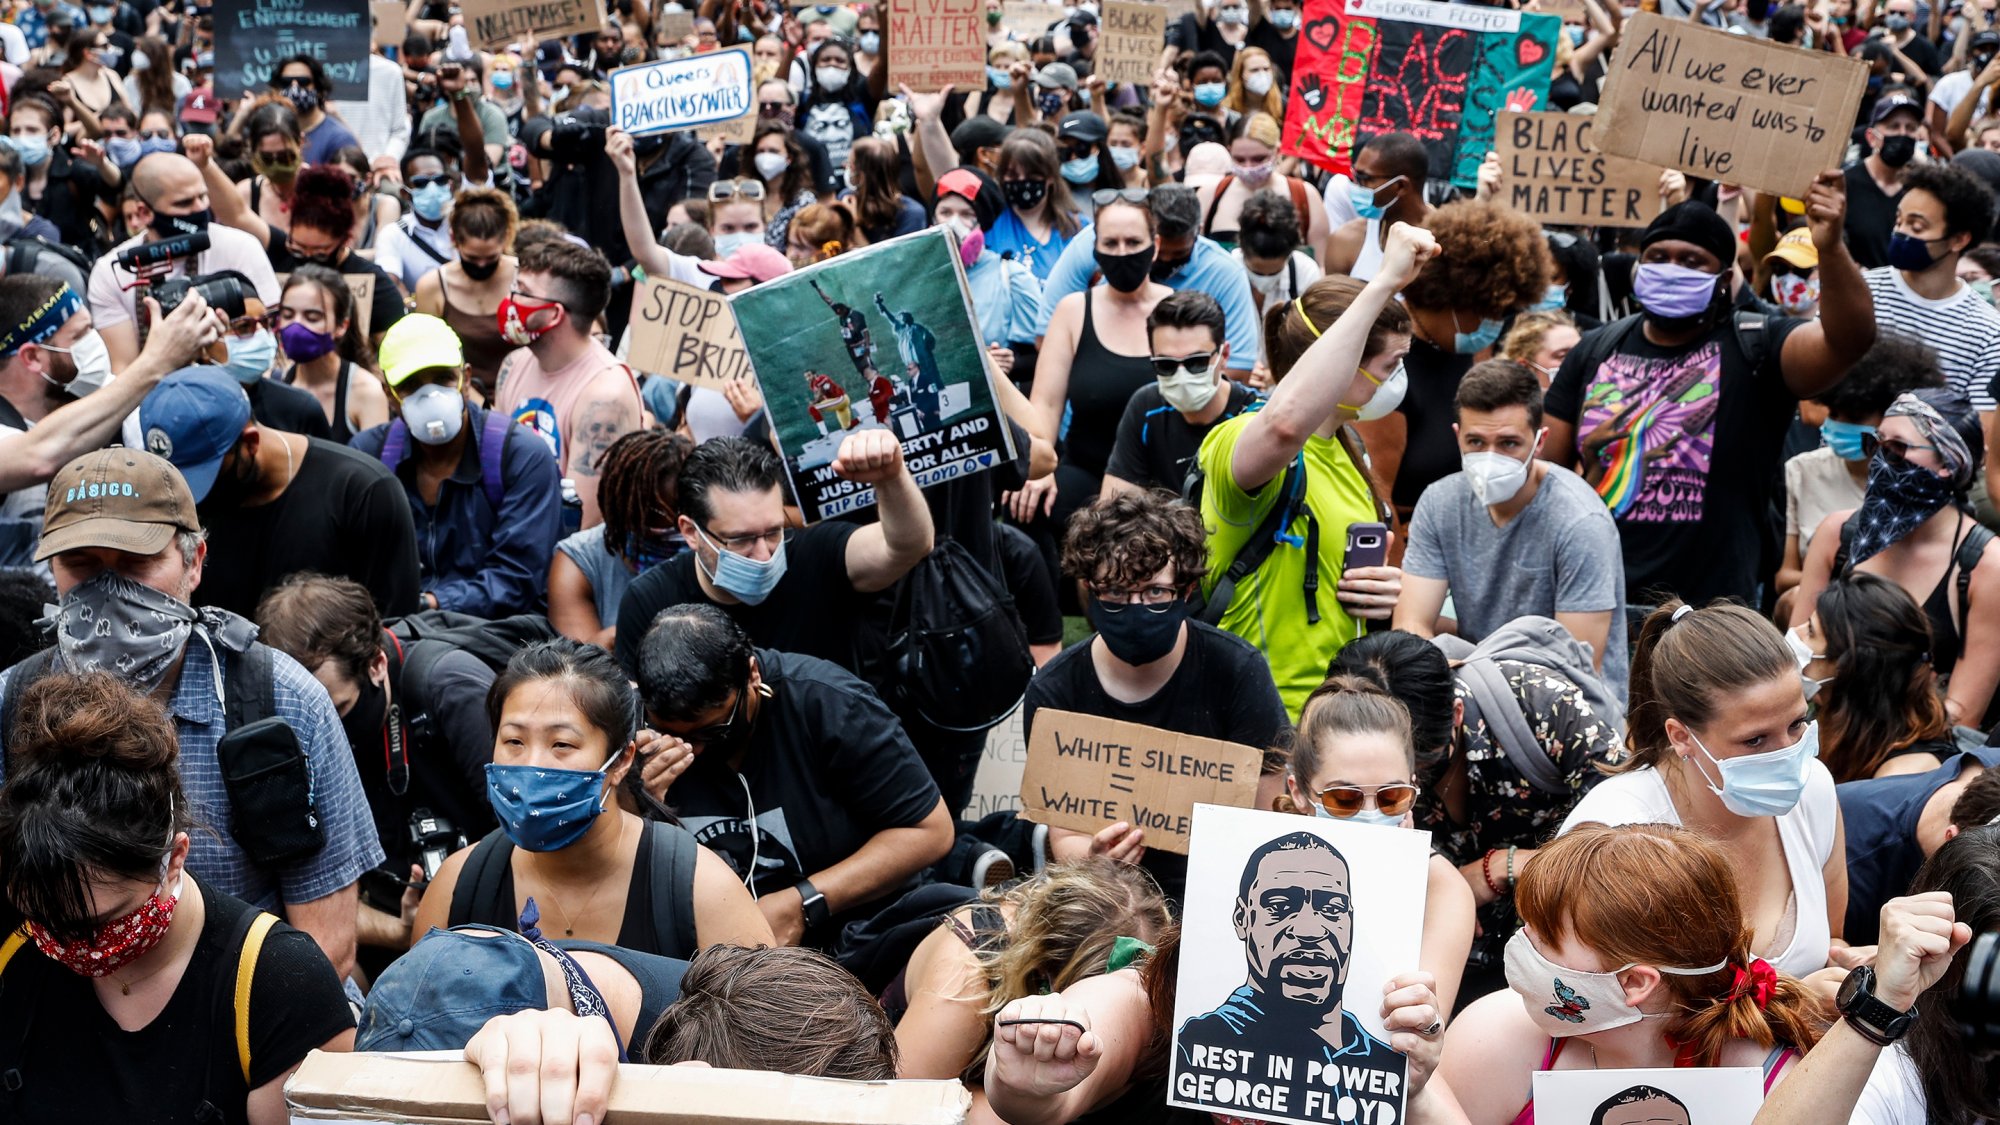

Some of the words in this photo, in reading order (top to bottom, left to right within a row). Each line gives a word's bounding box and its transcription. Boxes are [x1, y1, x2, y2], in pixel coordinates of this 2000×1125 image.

[238, 10, 361, 29] ENFORCEMENT
[1108, 7, 1157, 33] BLACK
[1366, 0, 1432, 20] GEORGE
[1449, 9, 1507, 28] FLOYD
[892, 16, 980, 45] MATTER
[254, 40, 327, 65] WHITE
[1105, 35, 1155, 58] LIVES
[1337, 20, 1508, 85] BLACK
[1103, 58, 1154, 79] MATTER
[1628, 28, 1680, 73] All
[1685, 58, 1726, 84] we
[1741, 68, 1818, 95] ever
[646, 68, 710, 89] Queers
[1642, 87, 1741, 122] wanted
[1752, 108, 1798, 133] was
[1804, 117, 1826, 143] to
[1513, 117, 1593, 153] BLAC
[1679, 127, 1734, 174] live
[1513, 155, 1606, 184] LIVES
[1512, 184, 1641, 220] MATTER
[642, 284, 721, 332] STOP
[942, 394, 949, 408] 3
[950, 418, 990, 437] AND
[941, 442, 987, 463] ALL...
[67, 479, 140, 502] BÁSICO.
[825, 500, 850, 517] RIP
[915, 465, 959, 486] FLOYD
[390, 704, 401, 752] Canon
[1055, 731, 1132, 767] WHITE
[1141, 750, 1234, 782] SILENCE
[1041, 786, 1119, 820] WHITE
[1132, 804, 1191, 835] VIOLE
[697, 822, 725, 843] NEW
[1191, 1044, 1254, 1074] REST
[1267, 1054, 1293, 1081] IN
[1306, 1060, 1400, 1097] POWER
[1177, 1072, 1290, 1113] GEORGE
[1305, 1090, 1396, 1125] FLOYD
